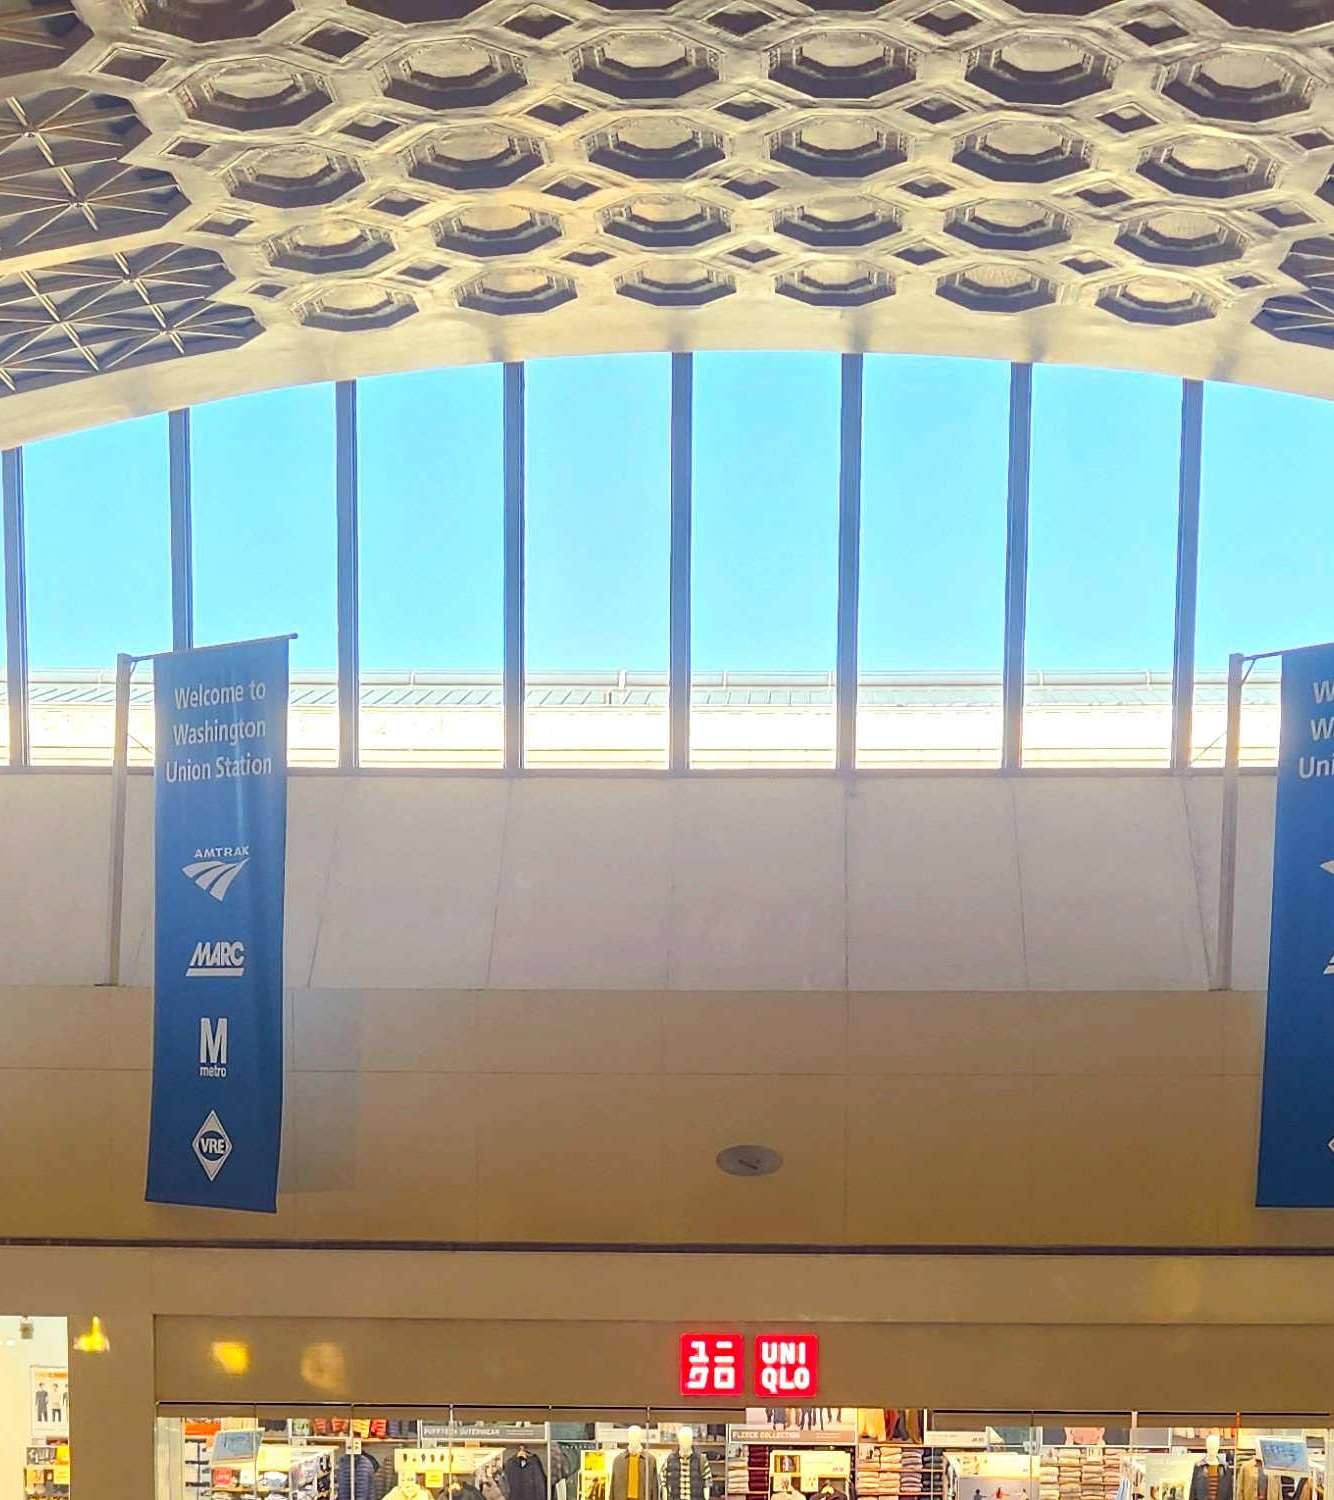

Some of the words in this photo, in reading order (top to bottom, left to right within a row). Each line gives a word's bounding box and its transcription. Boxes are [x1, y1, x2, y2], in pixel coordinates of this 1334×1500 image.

[175, 684, 243, 709] Welcome
[249, 680, 266, 700] to
[172, 719, 268, 748] Washington
[166, 759, 210, 782] Union
[216, 753, 274, 778] Station
[193, 846, 250, 859] AMTRAK
[191, 941, 244, 967] MARC
[200, 1018, 227, 1063] M
[200, 1065, 226, 1077] metro
[201, 1138, 225, 1156] VRE
[762, 1342, 806, 1364] UNI
[762, 1367, 810, 1393] QLO
